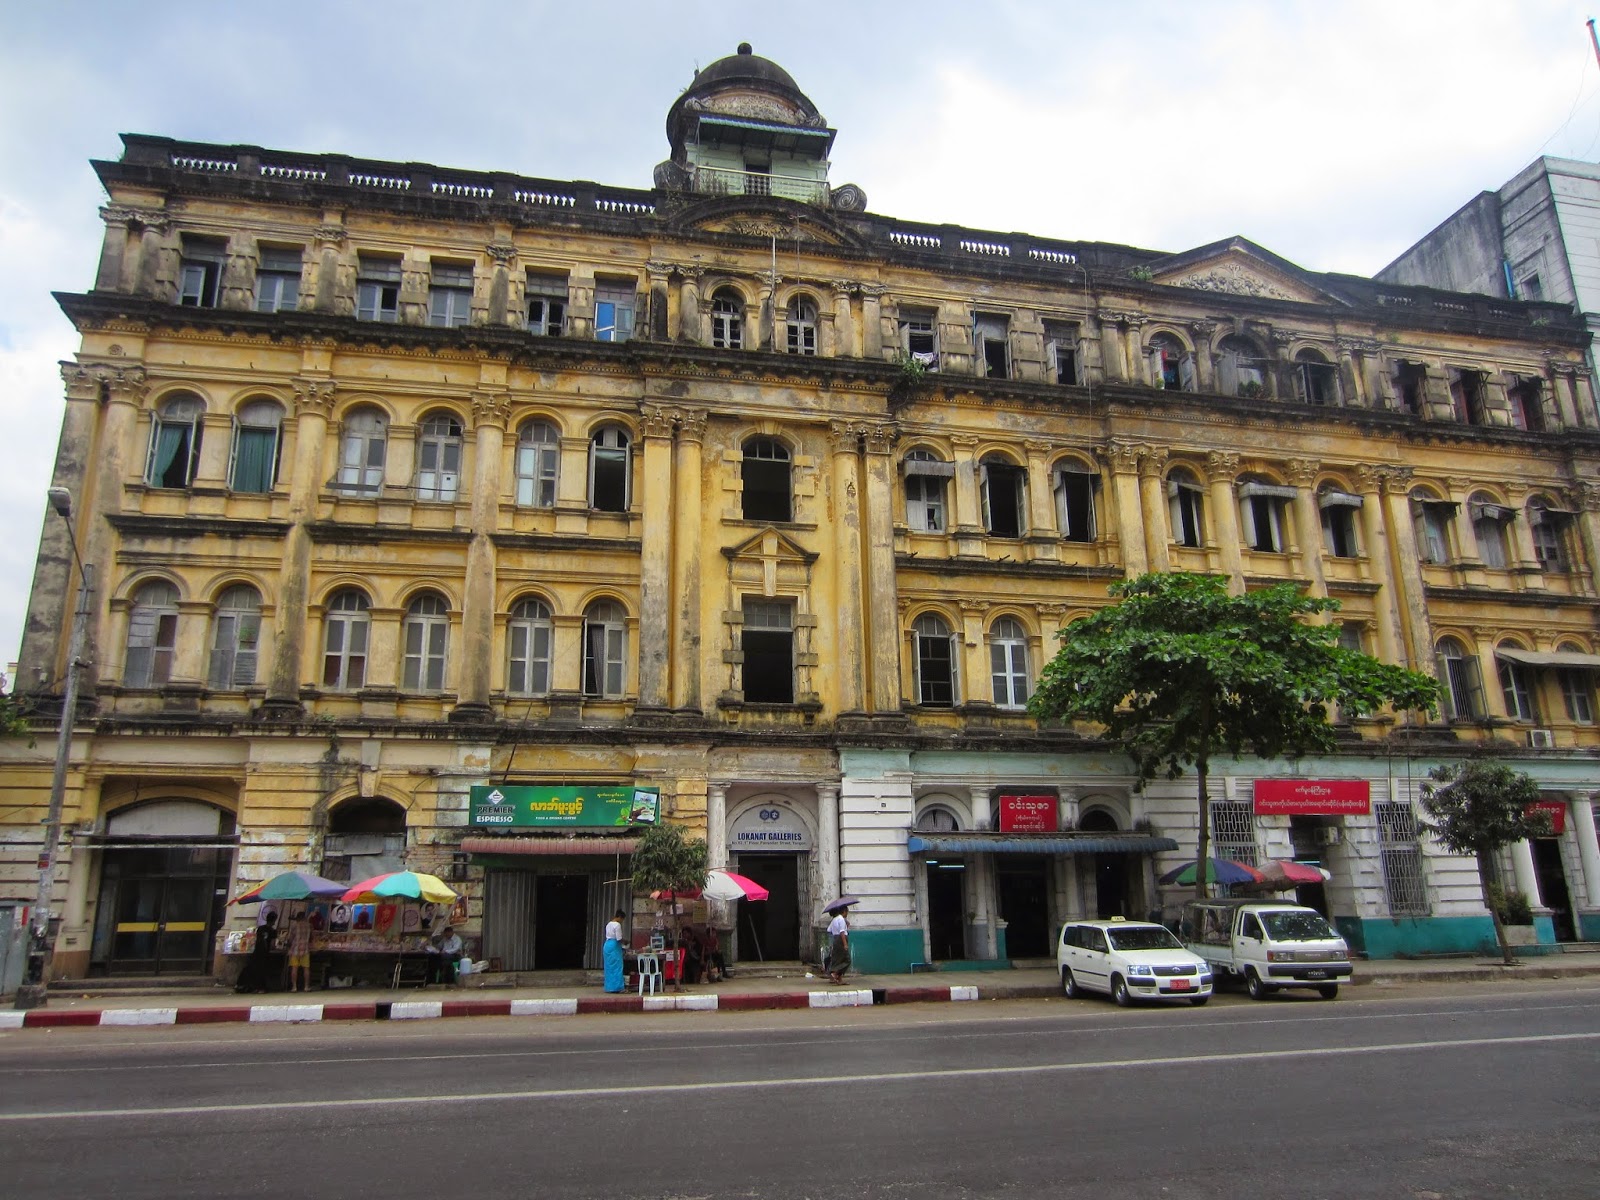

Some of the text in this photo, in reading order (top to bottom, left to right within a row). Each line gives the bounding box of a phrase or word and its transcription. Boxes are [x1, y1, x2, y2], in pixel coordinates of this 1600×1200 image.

[477, 806, 514, 814] PREMIER
[476, 815, 514, 823] ESPRESSO
[738, 833, 802, 841] LOKANAT GALLERIES
